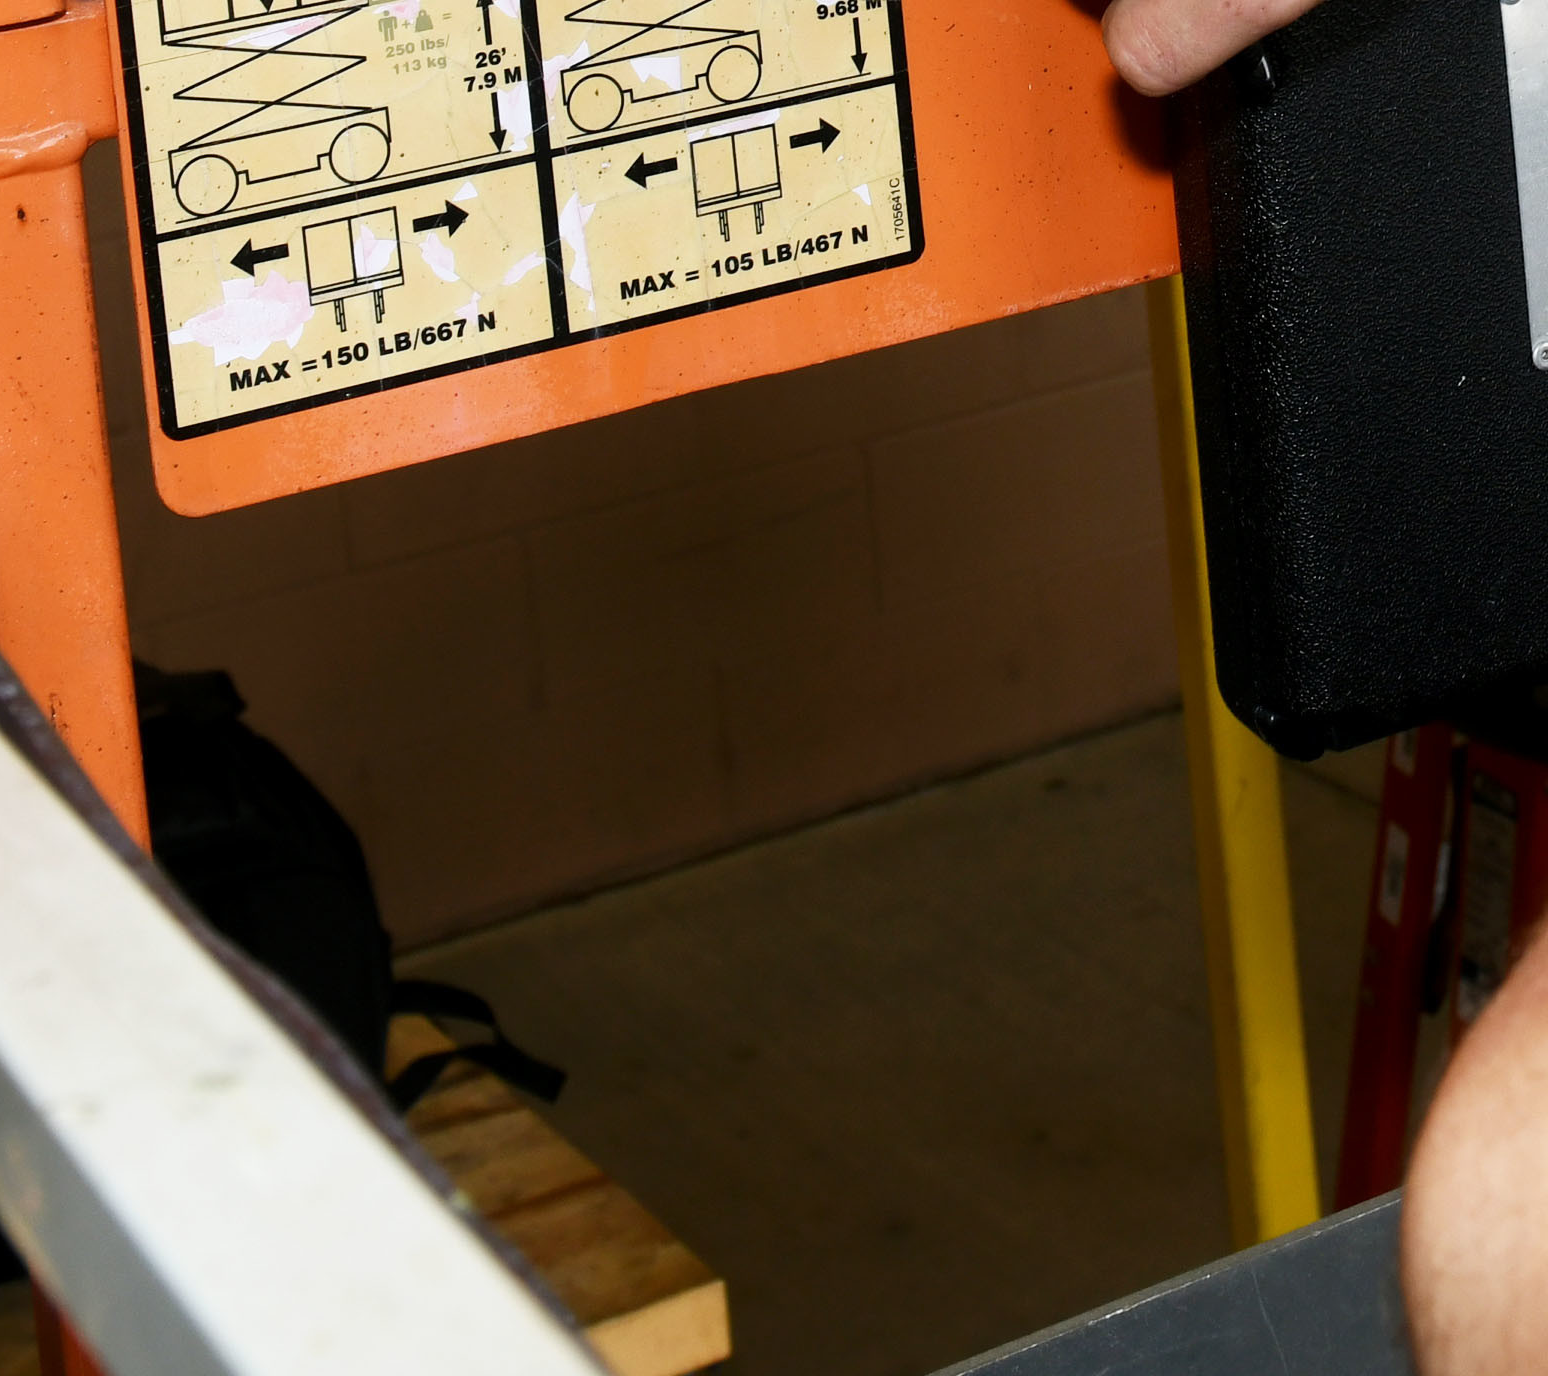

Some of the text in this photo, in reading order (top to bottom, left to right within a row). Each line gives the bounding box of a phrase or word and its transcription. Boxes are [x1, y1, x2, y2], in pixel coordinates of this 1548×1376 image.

[385, 34, 450, 58] 250 lbs/
[393, 55, 447, 75] 113 kg
[463, 65, 522, 93] 7.9 M
[889, 177, 903, 241] 1705641C
[619, 269, 676, 300] MAX
[711, 251, 754, 277] 105
[761, 230, 843, 266] LB/467
[851, 224, 868, 245] N
[229, 359, 291, 392] MAX
[378, 318, 467, 356] LB/667
[477, 310, 496, 332] N
